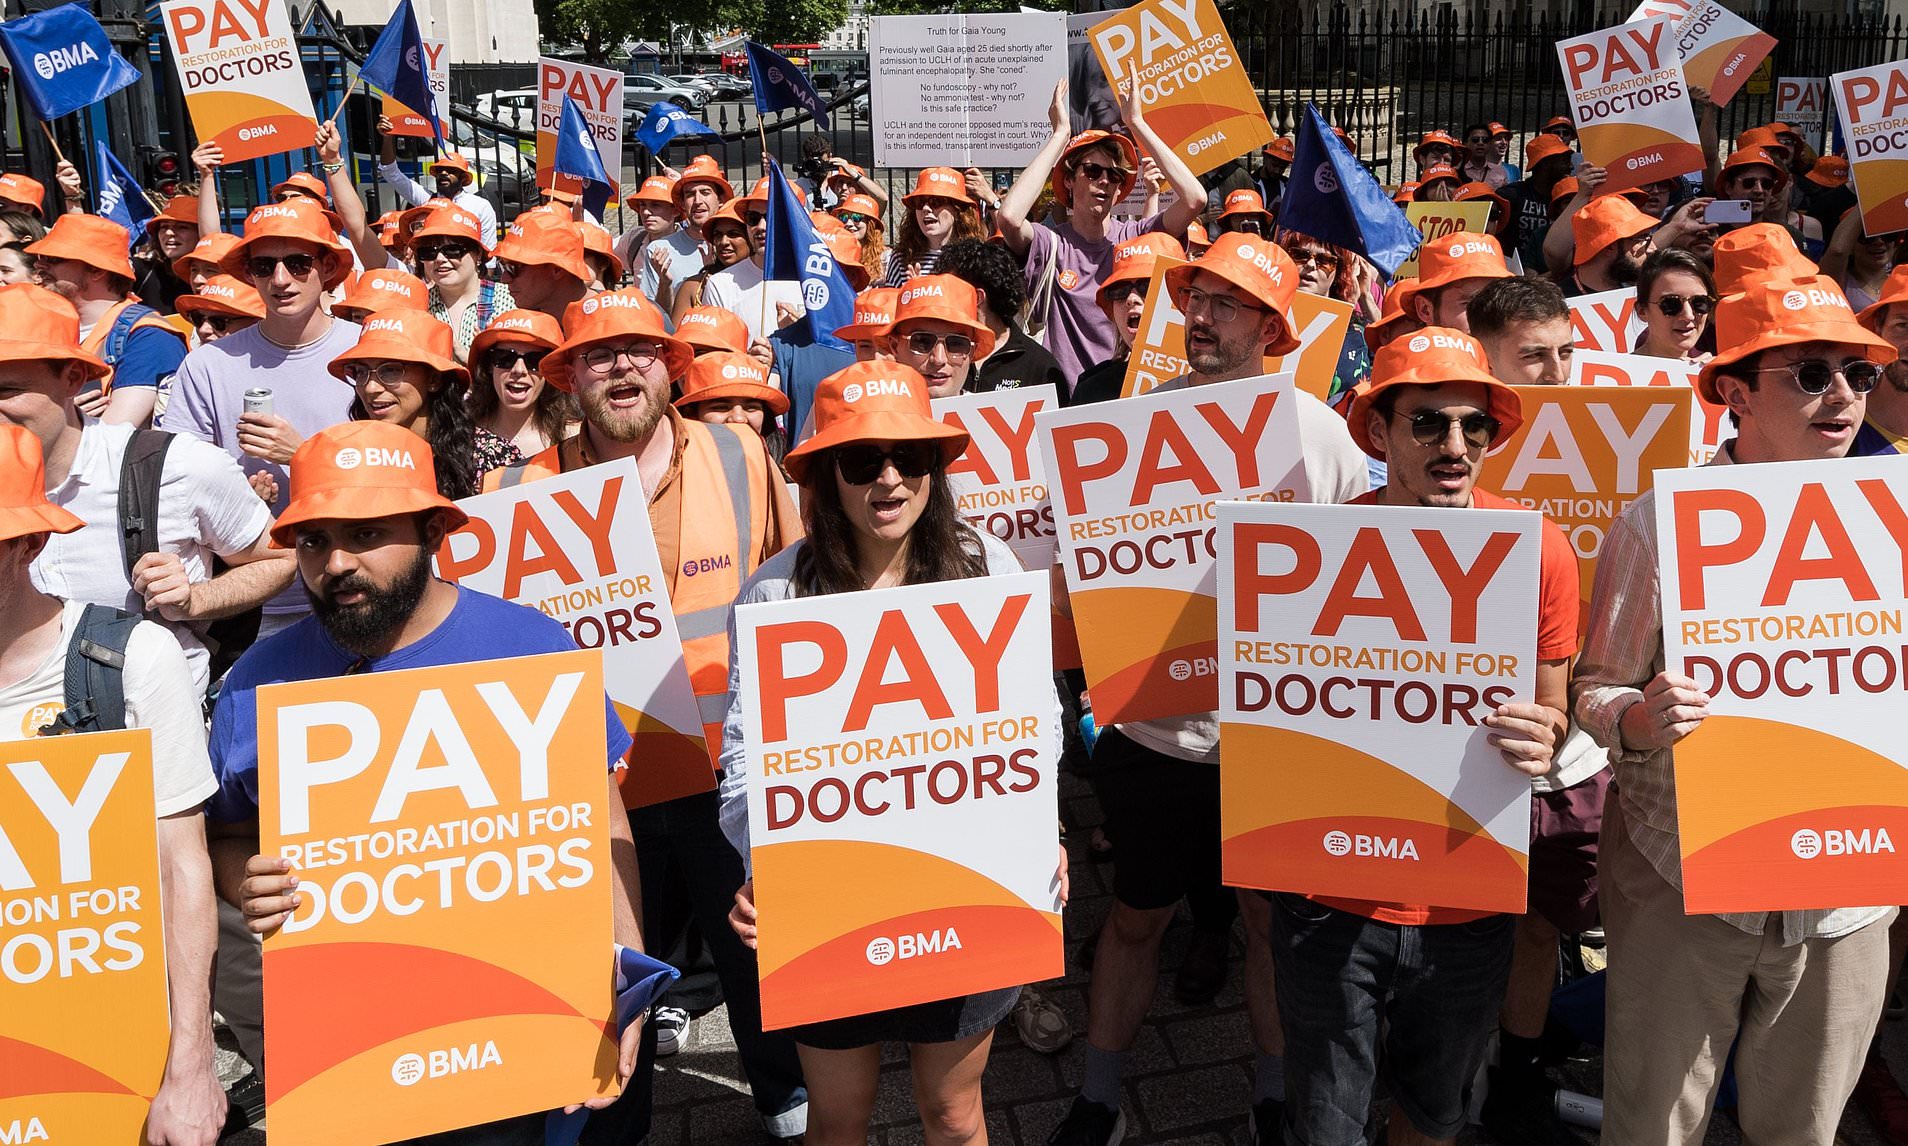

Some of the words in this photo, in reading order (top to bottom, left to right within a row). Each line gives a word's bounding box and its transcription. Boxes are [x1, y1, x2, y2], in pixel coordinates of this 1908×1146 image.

[169, 0, 272, 54] PAY
[927, 27, 947, 36] Truth
[948, 27, 960, 36] for
[961, 27, 980, 36] Gaia
[981, 26, 1006, 37] Young
[879, 46, 918, 56] Previously
[919, 45, 935, 54] well
[936, 45, 955, 54] Gaia
[956, 45, 976, 55] aged
[977, 44, 988, 53] 25
[989, 44, 1006, 53] died
[1007, 43, 1033, 54] shortly
[1034, 43, 1053, 53] after
[1095, 0, 1203, 81] PAY
[1198, 33, 1225, 54] FOR
[50, 41, 99, 73] BMA
[181, 41, 263, 68] RESTORATION
[264, 37, 289, 52] FOR
[880, 56, 918, 65] admission
[919, 56, 927, 64] to
[928, 56, 952, 64] UCLH
[953, 55, 962, 64] of
[974, 56, 996, 64] acute
[997, 55, 1044, 65] unexplained
[1564, 23, 1662, 91] PAY
[1729, 53, 1747, 71] BMA
[185, 50, 293, 89] DOCTORS
[880, 66, 915, 75] fulminant
[916, 66, 978, 77] encephalopathy.
[979, 65, 995, 75] She
[1140, 46, 1233, 105] OCTORS
[542, 64, 618, 113] PAY
[920, 83, 932, 92] No
[933, 83, 977, 93] fundoscopy
[983, 83, 999, 93] why
[1000, 82, 1018, 92] not?
[1575, 75, 1653, 103] RESTORATION
[1654, 68, 1677, 82] FOR
[1842, 69, 1908, 124] PA
[921, 94, 933, 103] No
[933, 94, 969, 102] ammonia
[970, 94, 985, 102] test
[991, 93, 1007, 104] why
[1008, 93, 1026, 102] not?
[921, 104, 928, 113] Is
[929, 104, 944, 113] this
[945, 104, 962, 113] safe
[963, 104, 998, 115] practice?
[1578, 81, 1682, 123] DOCTORS
[250, 123, 278, 139] BMA
[600, 114, 618, 126] FOR
[884, 121, 907, 130] UCLH
[908, 121, 923, 130] and
[924, 121, 937, 129] the
[938, 122, 968, 130] coroner
[969, 120, 1002, 131] opposed
[1003, 120, 1029, 129] mum's
[884, 132, 895, 140] for
[907, 131, 954, 141] independent
[955, 131, 998, 141] neurologist
[998, 131, 1007, 139] in
[1008, 131, 1029, 139] court.
[1030, 130, 1053, 141] Why?
[885, 142, 892, 150] Is
[892, 142, 907, 150] this
[908, 142, 944, 152] informed,
[945, 141, 989, 152] transparent
[990, 141, 1041, 151] investigation?
[1200, 131, 1227, 150] BMA
[1638, 152, 1664, 167] BMA
[940, 174, 957, 185] BMA
[264, 207, 298, 219] BMA
[463, 216, 479, 233] BMA
[1123, 244, 1152, 257] BMA
[1465, 242, 1496, 256] BMA
[1253, 253, 1283, 287] BMA
[208, 285, 235, 298] BMA
[385, 281, 411, 298] BMA
[912, 285, 943, 299] BMA
[1811, 290, 1850, 309] BMA
[601, 295, 641, 310] BMA
[368, 319, 403, 333] BMA
[504, 318, 533, 330] BMA
[691, 314, 717, 327] BMA
[863, 312, 890, 324] BMA
[1433, 335, 1476, 359] BMA
[865, 379, 912, 398] BMA
[365, 447, 415, 471] BMA
[1051, 392, 1280, 516] PAY
[1501, 403, 1676, 494] AY
[1020, 485, 1046, 502] FO
[435, 475, 624, 600] PAY
[700, 554, 731, 572] BMA
[607, 575, 653, 603] FOR
[1233, 522, 1522, 644] PAY
[1681, 610, 1902, 645] RESTORATION
[755, 593, 1033, 744] PAY
[1235, 640, 1446, 673] RESTORATION
[1456, 653, 1518, 677] FOR
[1235, 671, 1517, 727] DOCTORS
[277, 672, 586, 836] PAY
[763, 724, 973, 777] RESTORATION
[983, 716, 1039, 746] FOR
[765, 748, 1041, 831] DOCTORS
[280, 812, 519, 871] RESTORATION
[529, 802, 592, 835] FOR
[1355, 834, 1420, 861] BMA
[1824, 828, 1896, 856] BMA
[282, 838, 595, 935] DOCTORS
[70, 886, 141, 919] FOR
[897, 927, 962, 959] BMA
[429, 1040, 503, 1078] BMA
